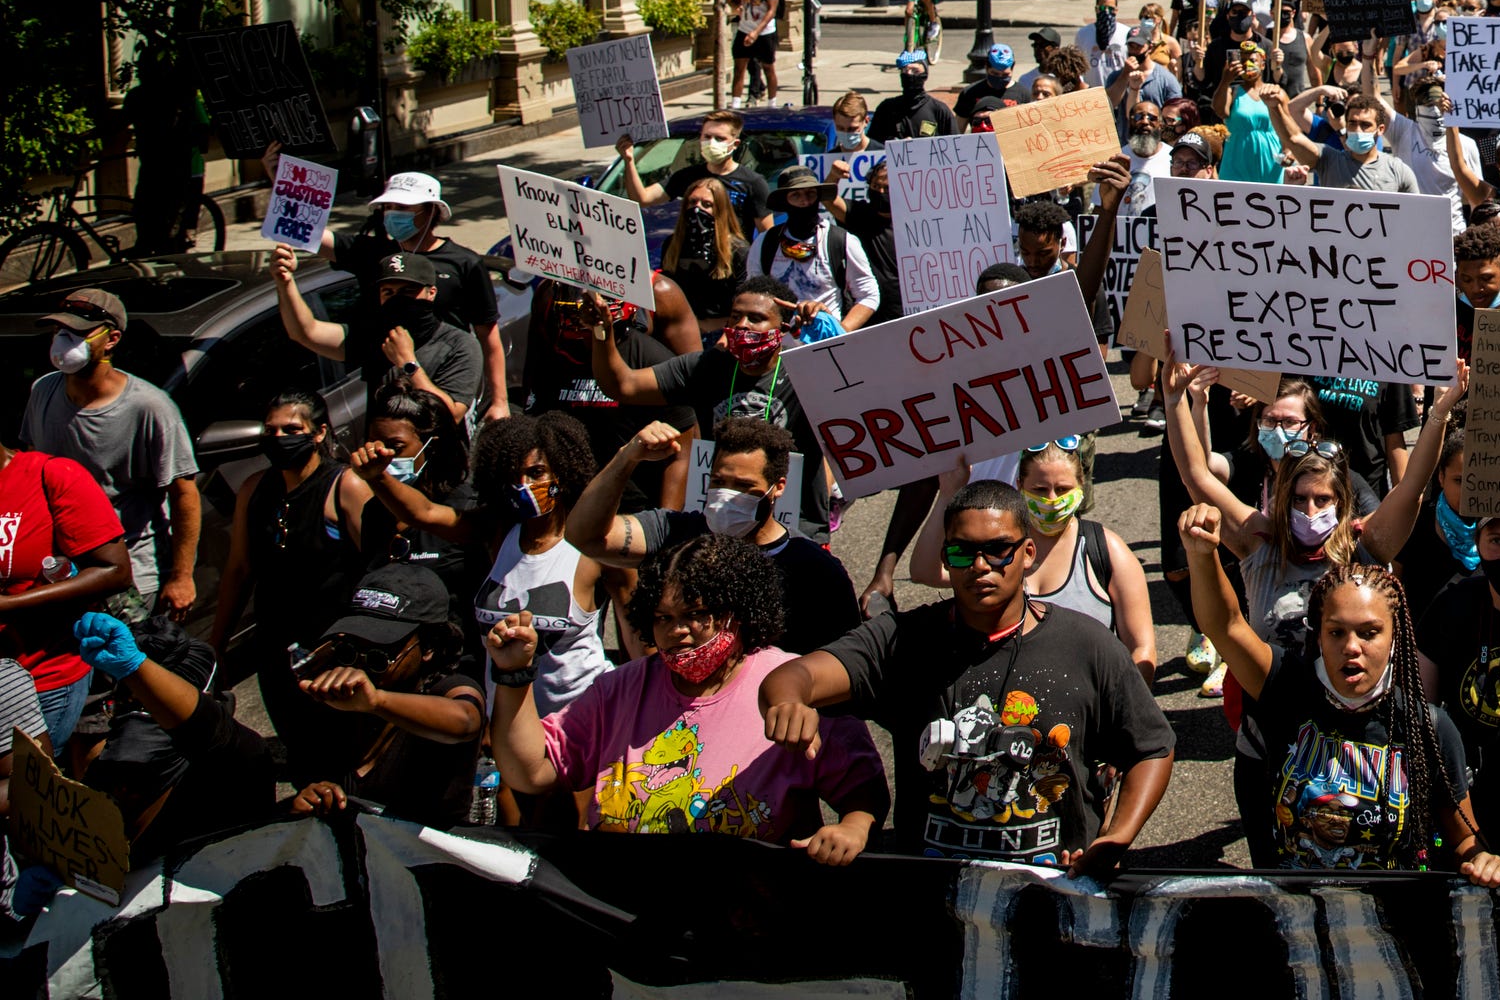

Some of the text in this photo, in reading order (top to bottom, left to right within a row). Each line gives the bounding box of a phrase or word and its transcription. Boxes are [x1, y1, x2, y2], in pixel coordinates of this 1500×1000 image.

[1452, 21, 1487, 47] BE
[185, 23, 305, 105] FUCK
[1447, 50, 1492, 73] TAKE
[217, 107, 266, 152] THE
[1016, 106, 1043, 129] NO
[889, 135, 994, 168] WE ARE A
[1024, 132, 1049, 155] NO
[275, 179, 332, 210] JUSTICE
[898, 164, 998, 213] VOICE
[515, 176, 638, 236] Know Justice
[1177, 187, 1401, 240] RESPECT
[273, 216, 314, 243] PEACE
[545, 212, 584, 236] BLM
[904, 212, 992, 248] NOT AN
[515, 223, 637, 285] Know Peace!
[1163, 236, 1399, 290] EXISTANCE
[1406, 258, 1456, 285] OR
[1227, 290, 1397, 332] EXPECT
[812, 294, 1031, 393] I CAN'T
[1125, 330, 1151, 353] BLM
[1181, 322, 1455, 382] RESISTANCE
[1317, 387, 1365, 414] MATTER
[1348, 377, 1380, 398] LIVES
[817, 347, 1111, 481] BREATHE
[410, 552, 440, 560] Medium
[24, 753, 90, 829] BLACK
[930, 821, 1056, 851] TUNE
